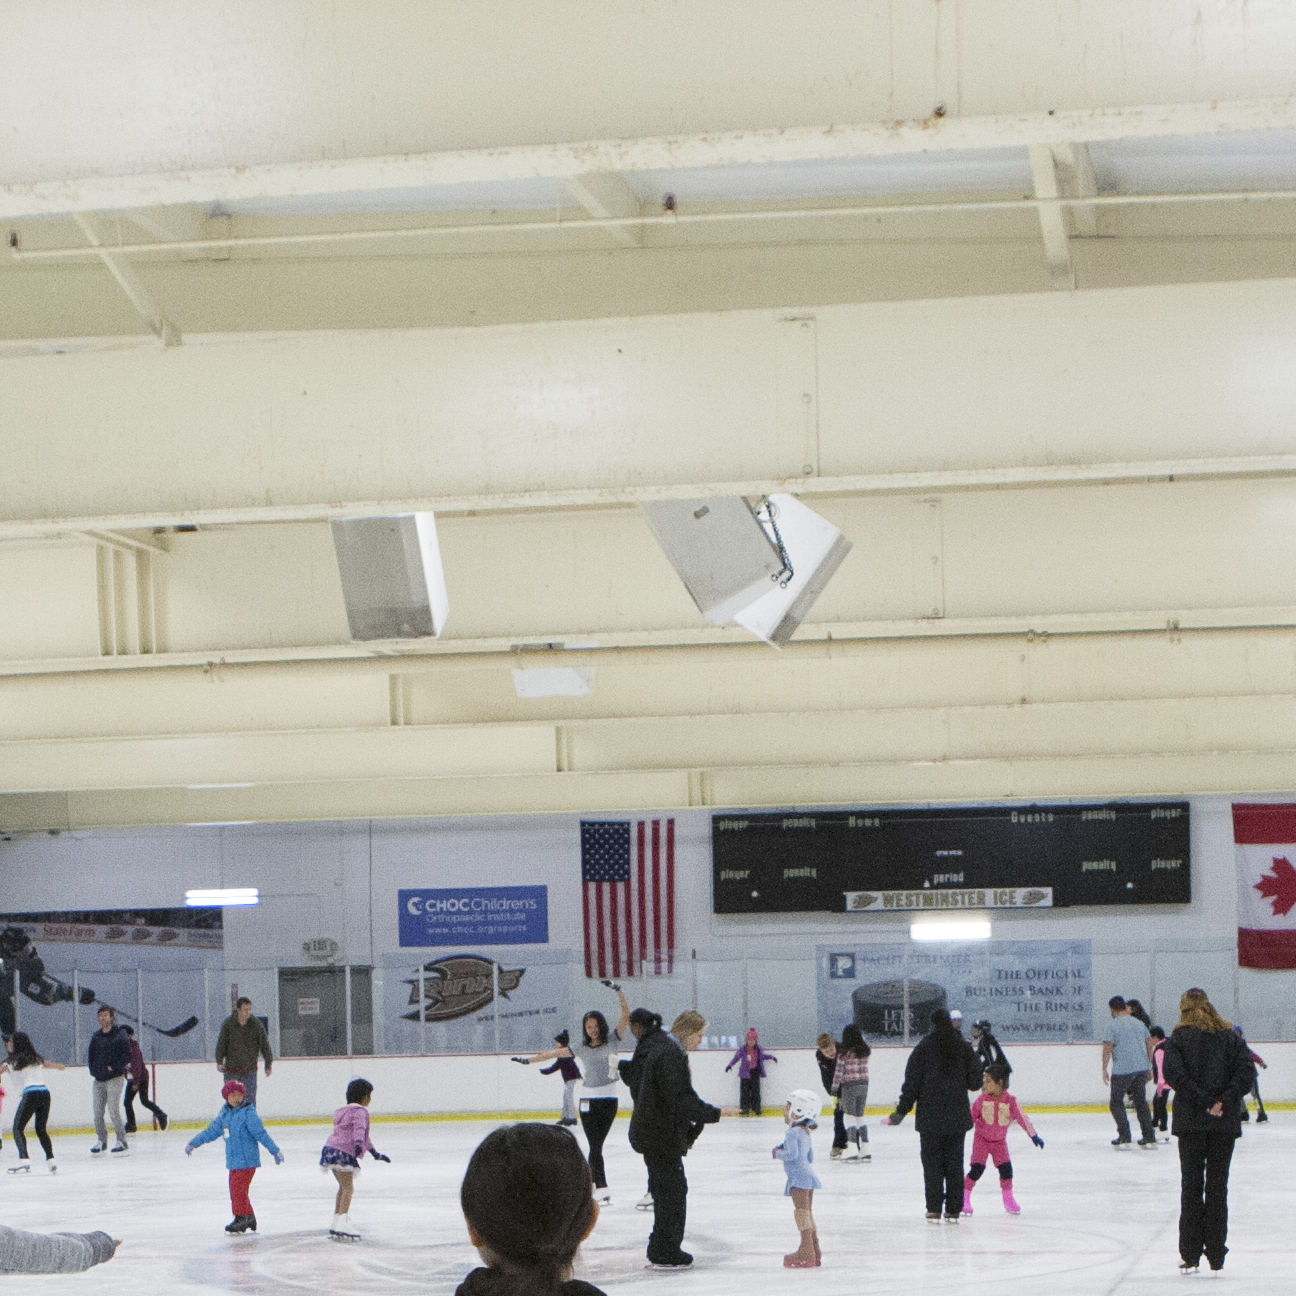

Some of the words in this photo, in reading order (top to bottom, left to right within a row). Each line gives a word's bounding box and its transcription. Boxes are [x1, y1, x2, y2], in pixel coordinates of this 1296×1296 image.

[848, 815, 881, 828] Home
[1011, 812, 1054, 823] Guests
[1082, 859, 1116, 872] penalty
[784, 867, 817, 879] penalty
[933, 871, 964, 884] period
[882, 890, 986, 908] WESTMINSTER
[993, 889, 1017, 906] ICE
[425, 898, 470, 912] CHOC
[487, 912, 526, 921] Institute
[996, 968, 1023, 980] THE
[1028, 984, 1064, 996] BANK
[1015, 1001, 1041, 1013] THE
